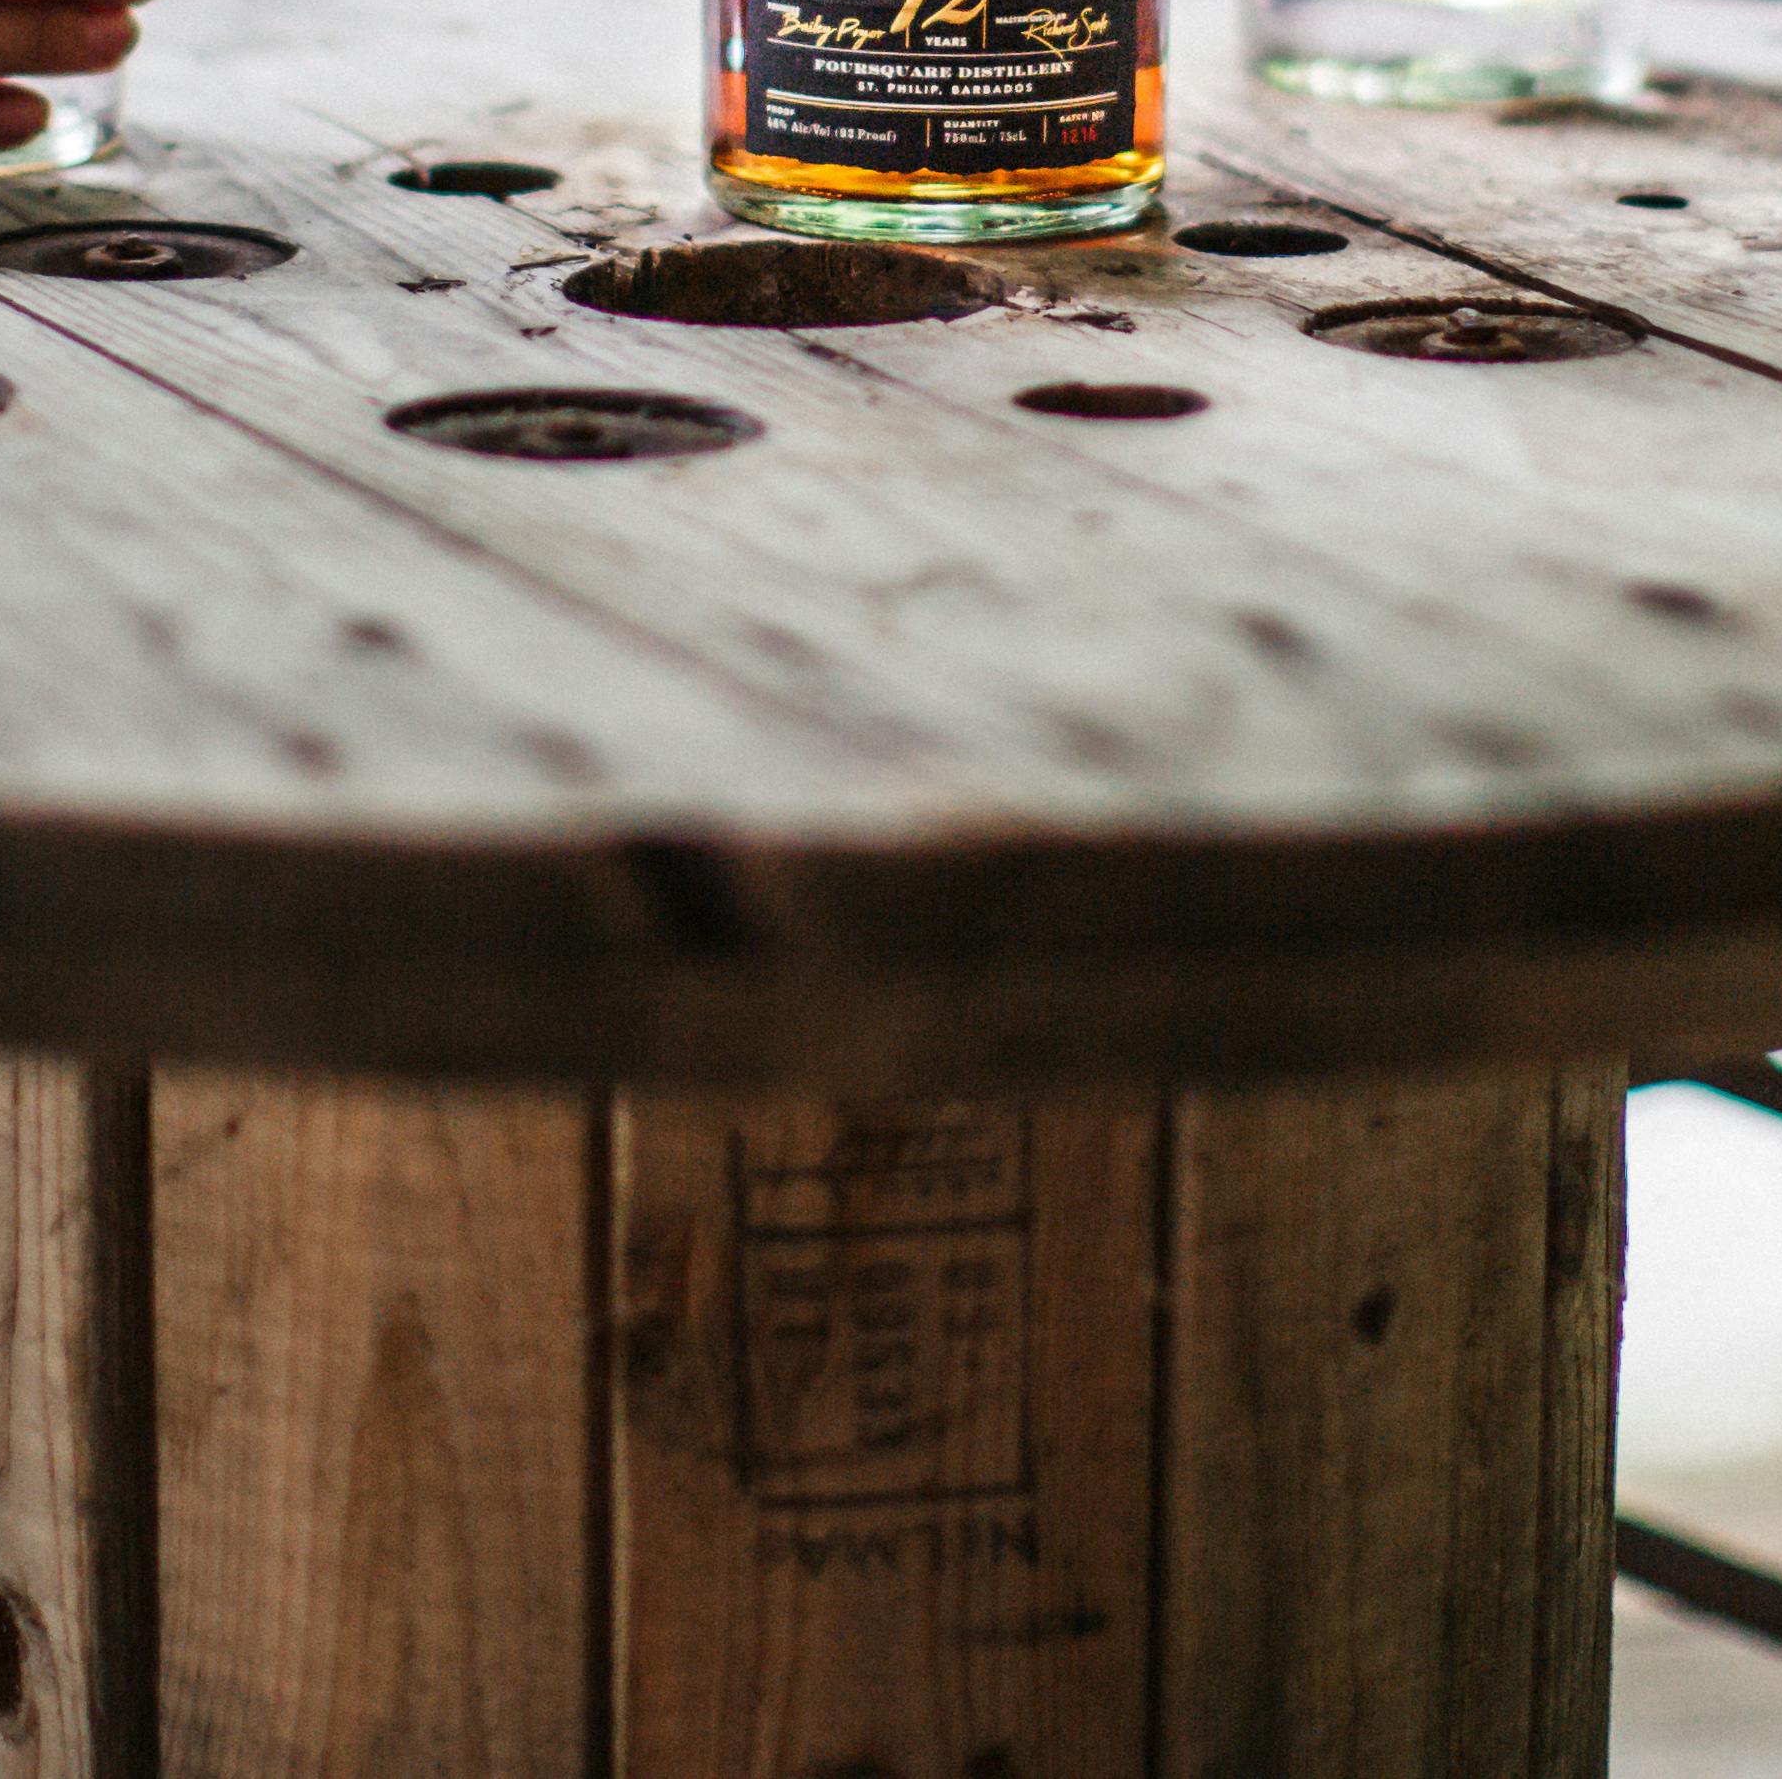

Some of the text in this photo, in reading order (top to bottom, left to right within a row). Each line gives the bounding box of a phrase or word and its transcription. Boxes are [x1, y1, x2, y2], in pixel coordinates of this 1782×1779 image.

[924, 36, 969, 47] YEARS
[814, 58, 1075, 79] FOURSQUARE DISTILLERY
[857, 81, 879, 94] ST.
[951, 83, 1033, 95] BARBADOS
[943, 120, 1000, 129] QUANTITY
[857, 128, 897, 143] Proof)
